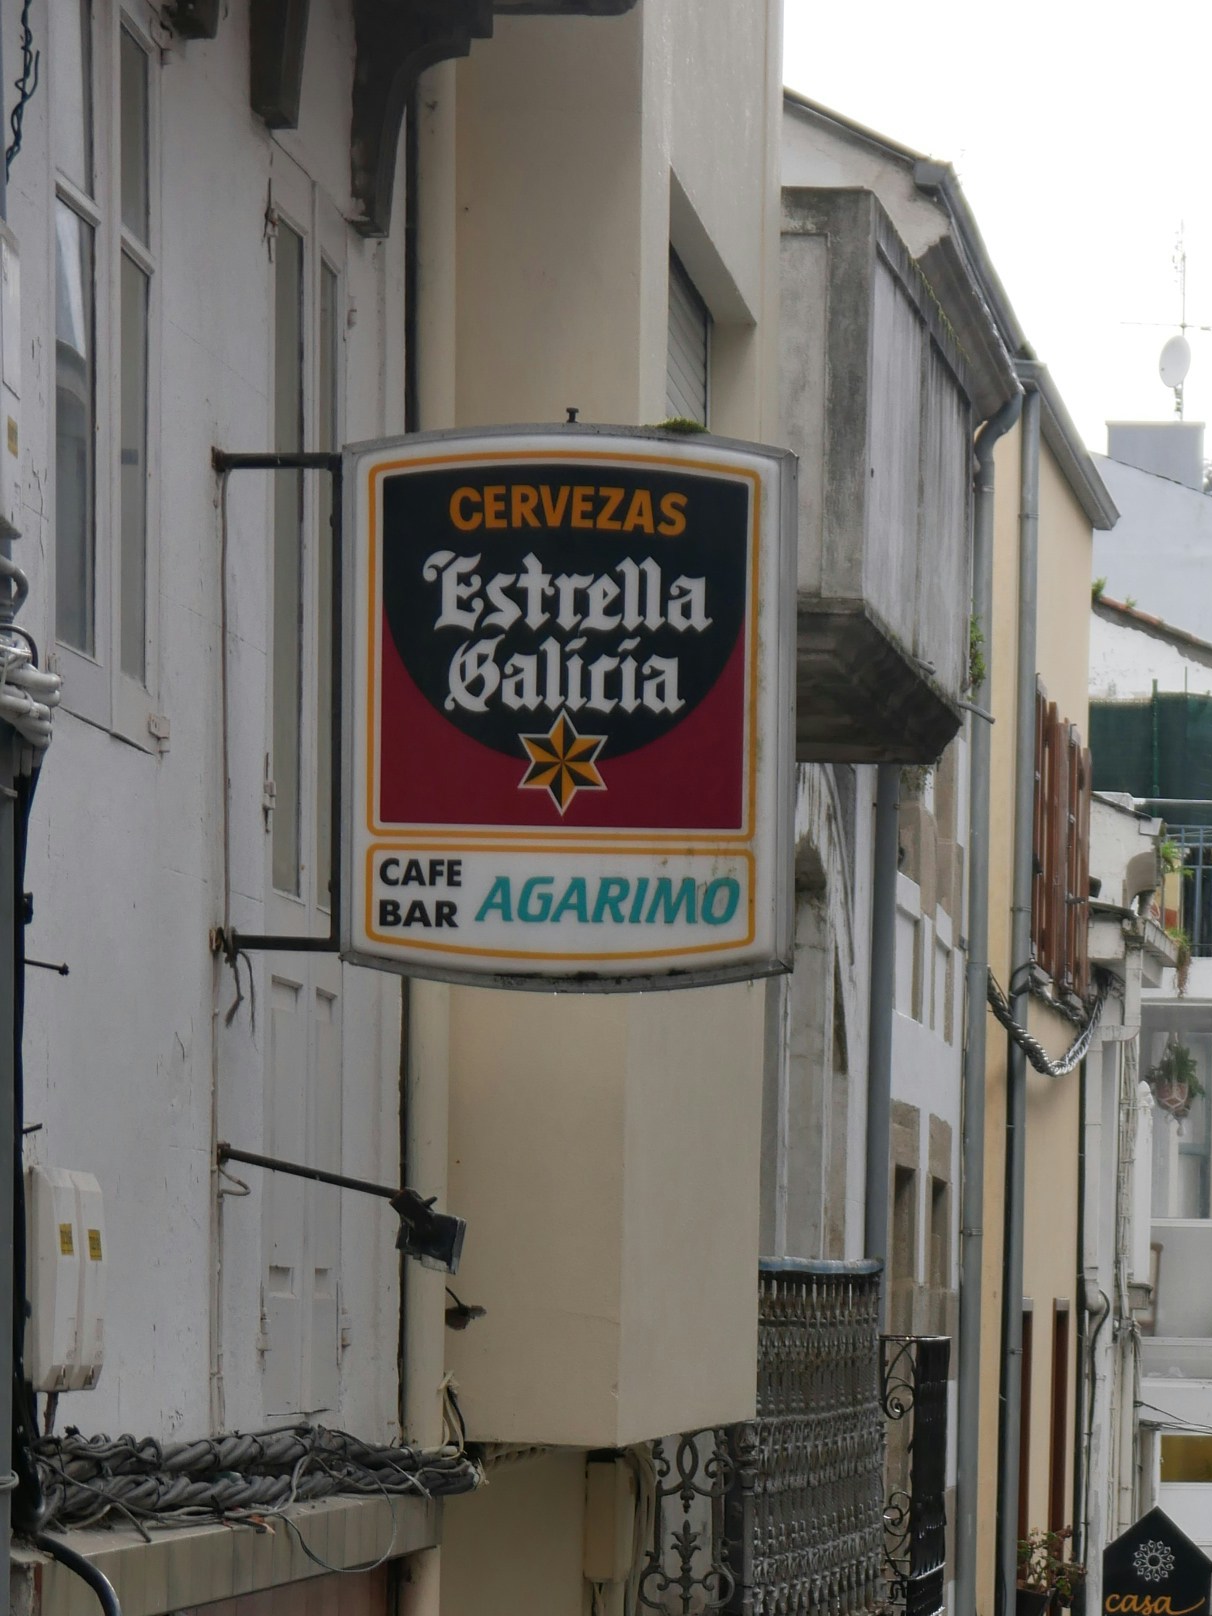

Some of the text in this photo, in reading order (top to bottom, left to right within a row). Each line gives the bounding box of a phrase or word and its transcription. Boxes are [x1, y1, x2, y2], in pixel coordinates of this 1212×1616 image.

[449, 484, 688, 537] CERVEZAS
[422, 549, 713, 634] Estrella
[444, 633, 686, 714] Galicia
[379, 858, 462, 888] CAFE
[379, 899, 459, 928] BAR
[474, 876, 740, 925] AGARIMO
[1105, 1593, 1206, 1616] casa
